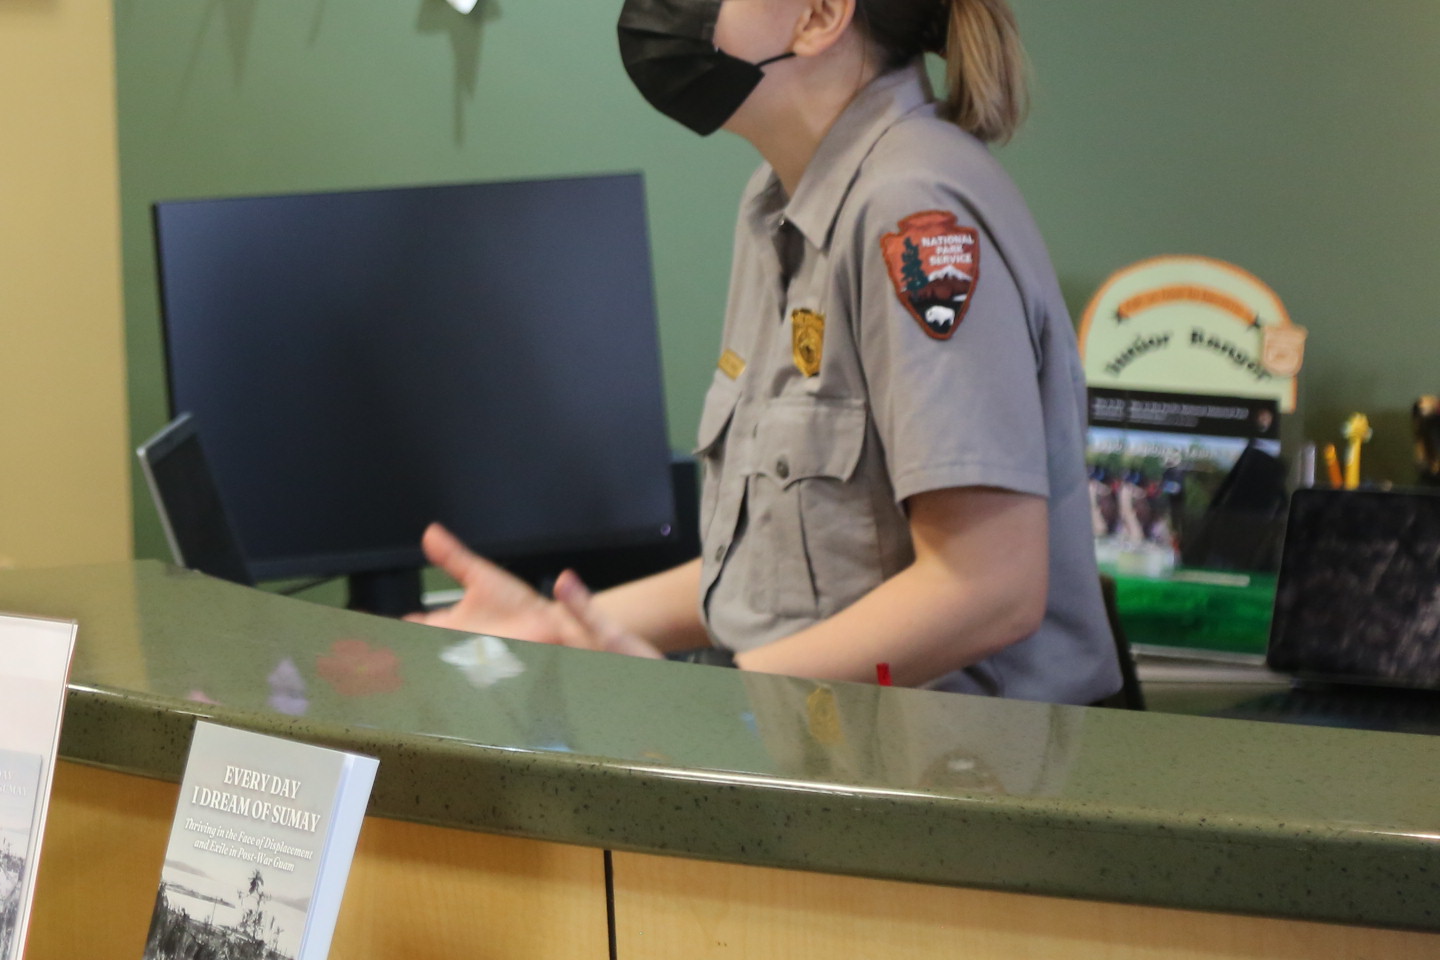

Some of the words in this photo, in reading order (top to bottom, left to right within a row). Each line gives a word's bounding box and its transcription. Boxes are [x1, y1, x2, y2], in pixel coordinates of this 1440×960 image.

[921, 234, 974, 248] NATIONAL
[936, 244, 964, 255] PARK
[929, 253, 973, 266] SERVICE
[223, 765, 270, 792] EVERY
[271, 776, 301, 799] DAY
[192, 785, 200, 804] I
[200, 787, 251, 817] DREAM
[251, 800, 271, 821] OF
[271, 804, 320, 833] SUMAY
[184, 818, 217, 838] Thriving
[217, 825, 225, 837] in
[225, 828, 237, 841] the
[238, 831, 255, 845] Face
[255, 836, 265, 850] of
[264, 837, 313, 860] Displacement
[194, 839, 209, 850] and
[209, 842, 228, 855] Exile
[229, 846, 237, 857] in
[237, 847, 273, 867] Post-War
[273, 857, 295, 872] Guam
